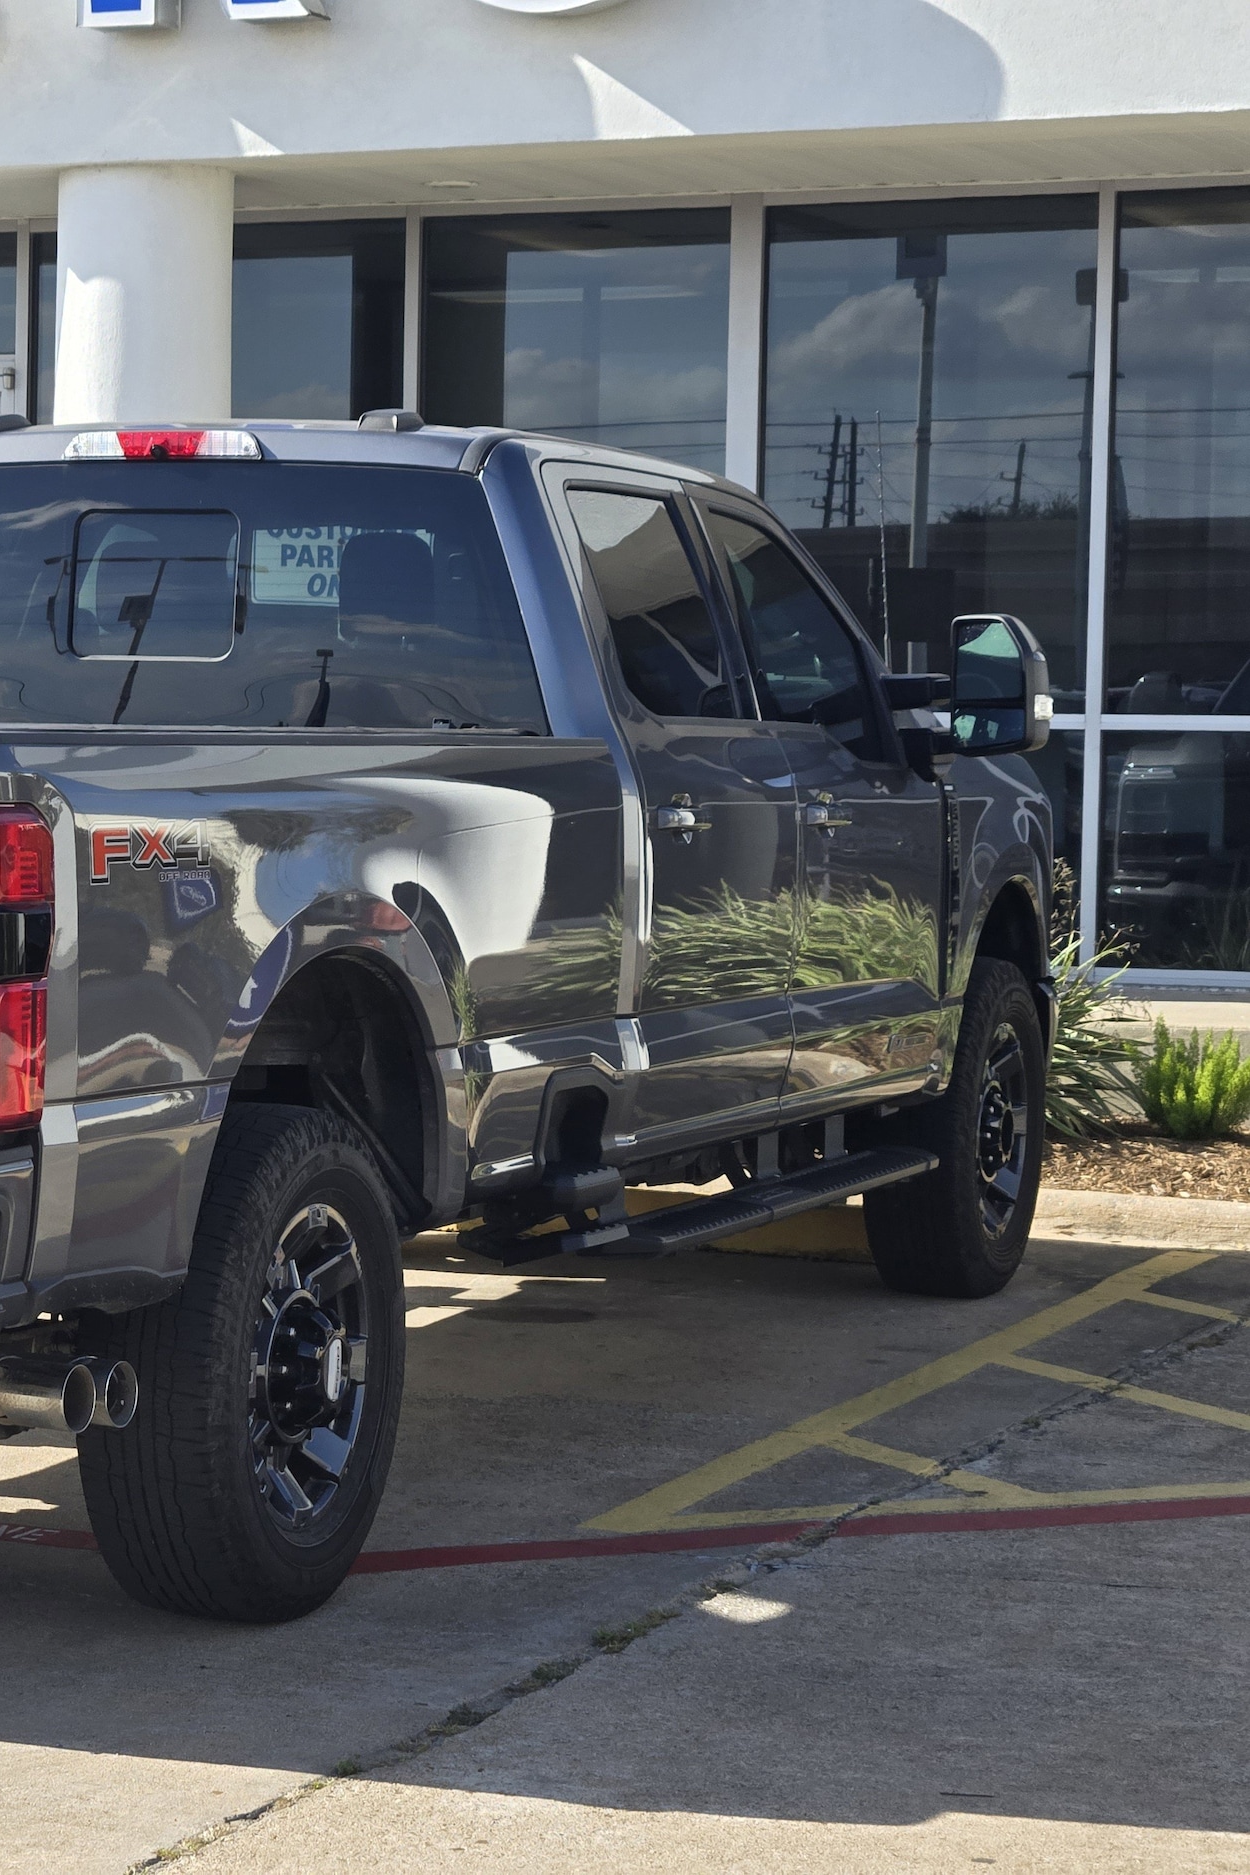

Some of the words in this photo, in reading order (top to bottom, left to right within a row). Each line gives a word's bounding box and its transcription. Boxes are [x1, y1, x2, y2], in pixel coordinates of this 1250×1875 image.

[89, 818, 211, 885] FX4
[159, 871, 180, 882] OFF
[183, 869, 211, 881] ROAD
